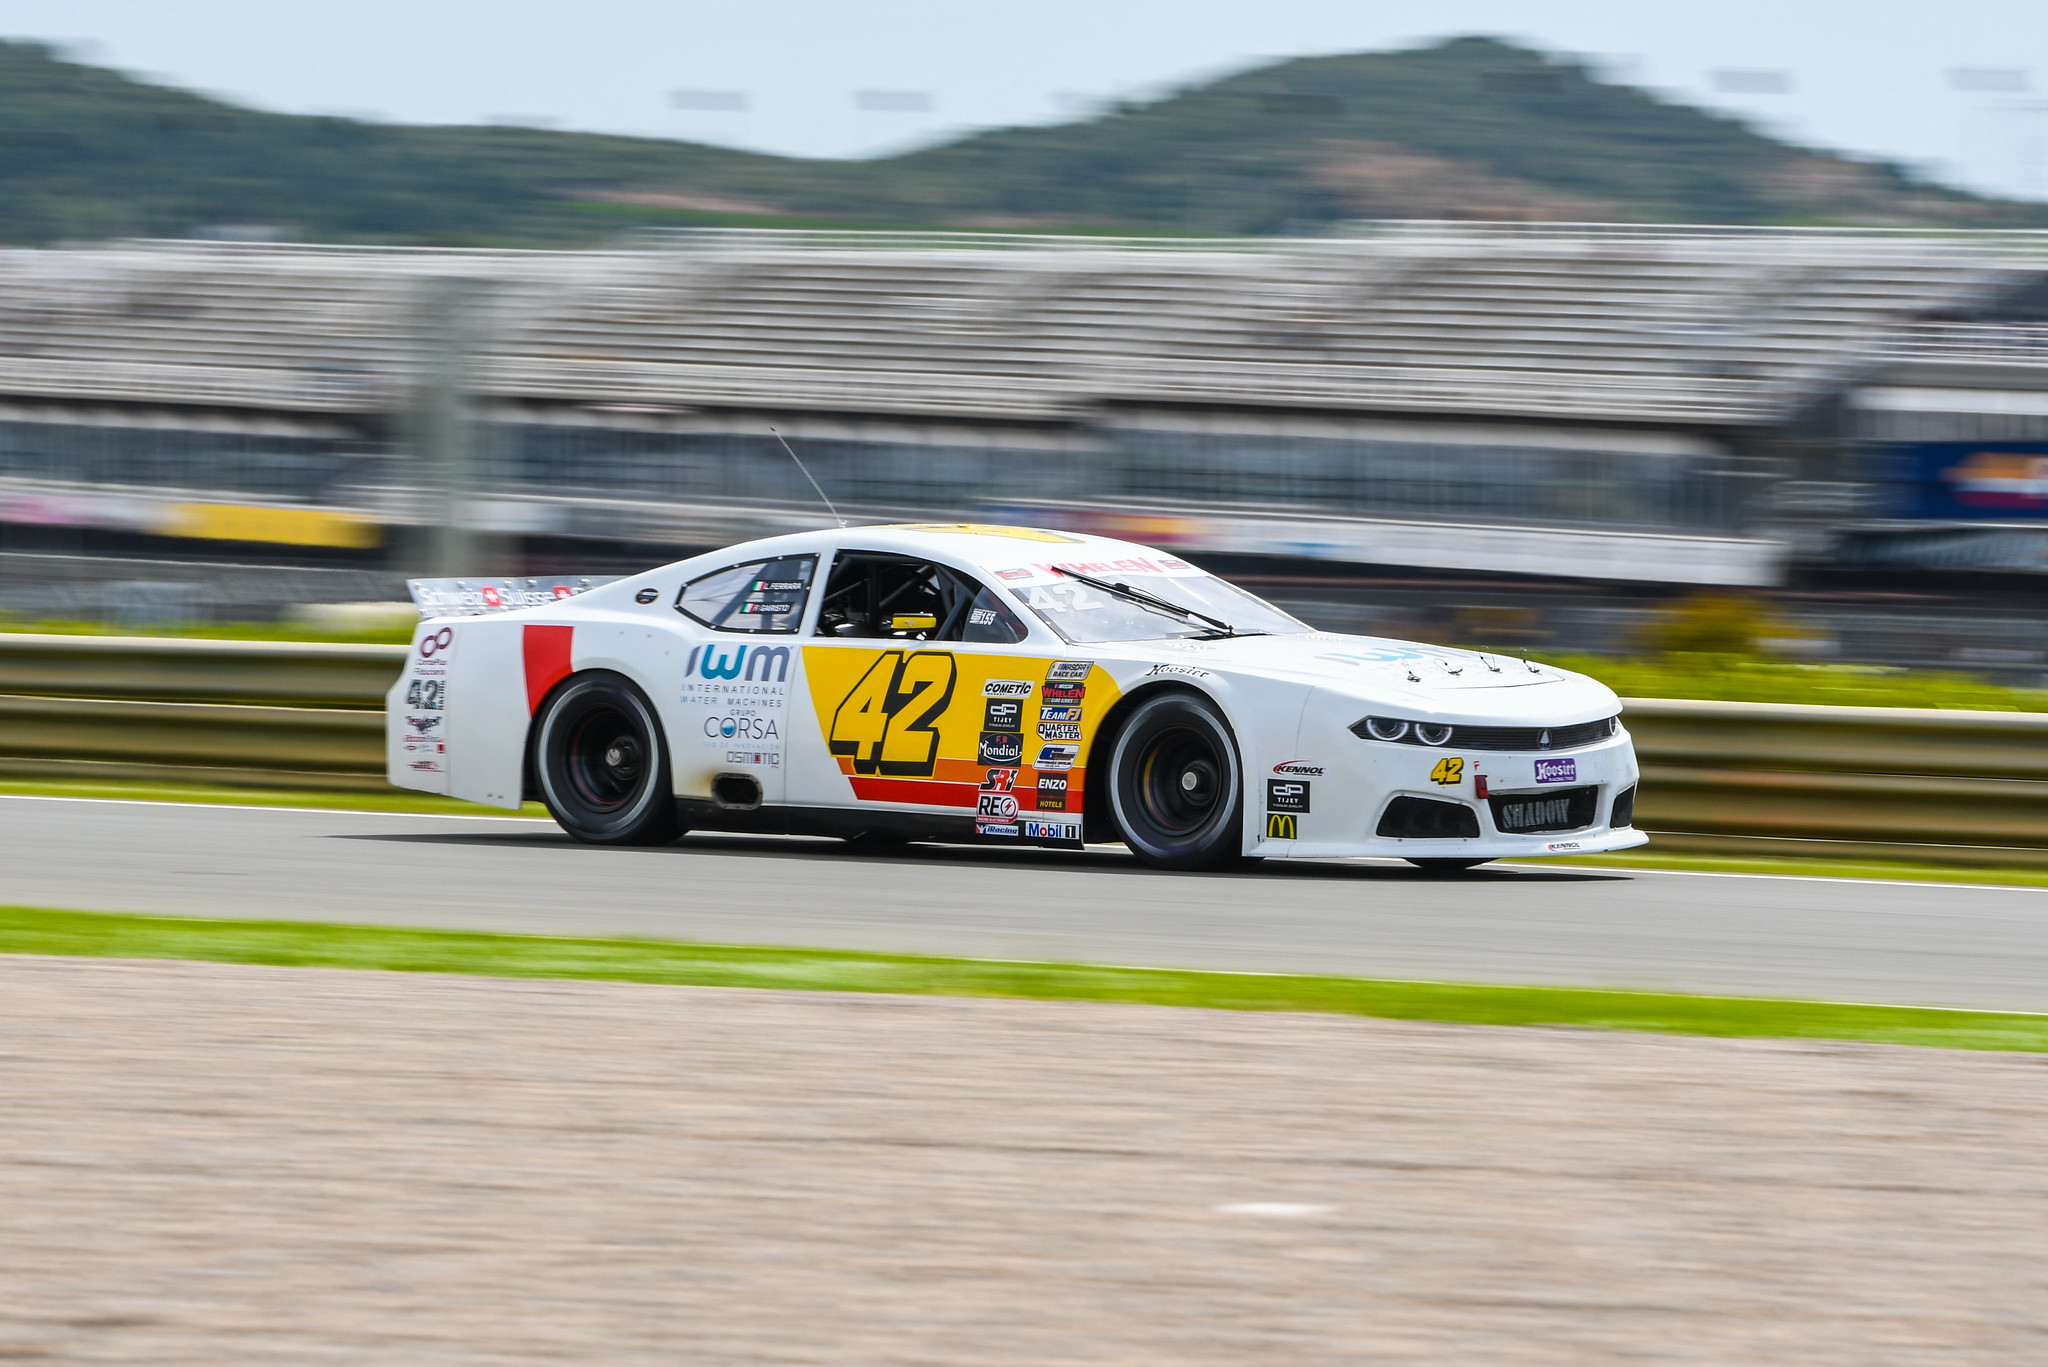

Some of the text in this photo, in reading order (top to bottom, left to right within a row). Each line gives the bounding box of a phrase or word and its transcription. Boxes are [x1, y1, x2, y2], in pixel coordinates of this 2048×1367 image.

[1031, 556, 1165, 578] WHELEN
[419, 587, 558, 605] Schweiz Suisse
[1028, 585, 1104, 613] 42
[980, 612, 997, 625] 155
[406, 679, 438, 709] 42
[681, 684, 784, 695] INTERNATIONAL
[985, 682, 1031, 694] COMETIC
[1042, 686, 1085, 699] WHELEN
[680, 696, 782, 708] WATER MACHINES
[730, 709, 756, 717] GRUPO
[829, 650, 957, 777] 42
[704, 716, 779, 740] CORSA
[1038, 723, 1078, 734] QUARTER
[1045, 731, 1080, 739] MASTER
[979, 740, 1022, 760] Mondial
[727, 751, 779, 765] OSMOTIC
[1277, 765, 1325, 775] KENNOL
[1431, 757, 1464, 785] 42
[1038, 779, 1067, 790] ENZO
[1040, 800, 1063, 809] HOTELS
[1502, 798, 1570, 829] SHADOW
[987, 825, 1018, 834] iRacing
[1029, 823, 1063, 837] Mobil
